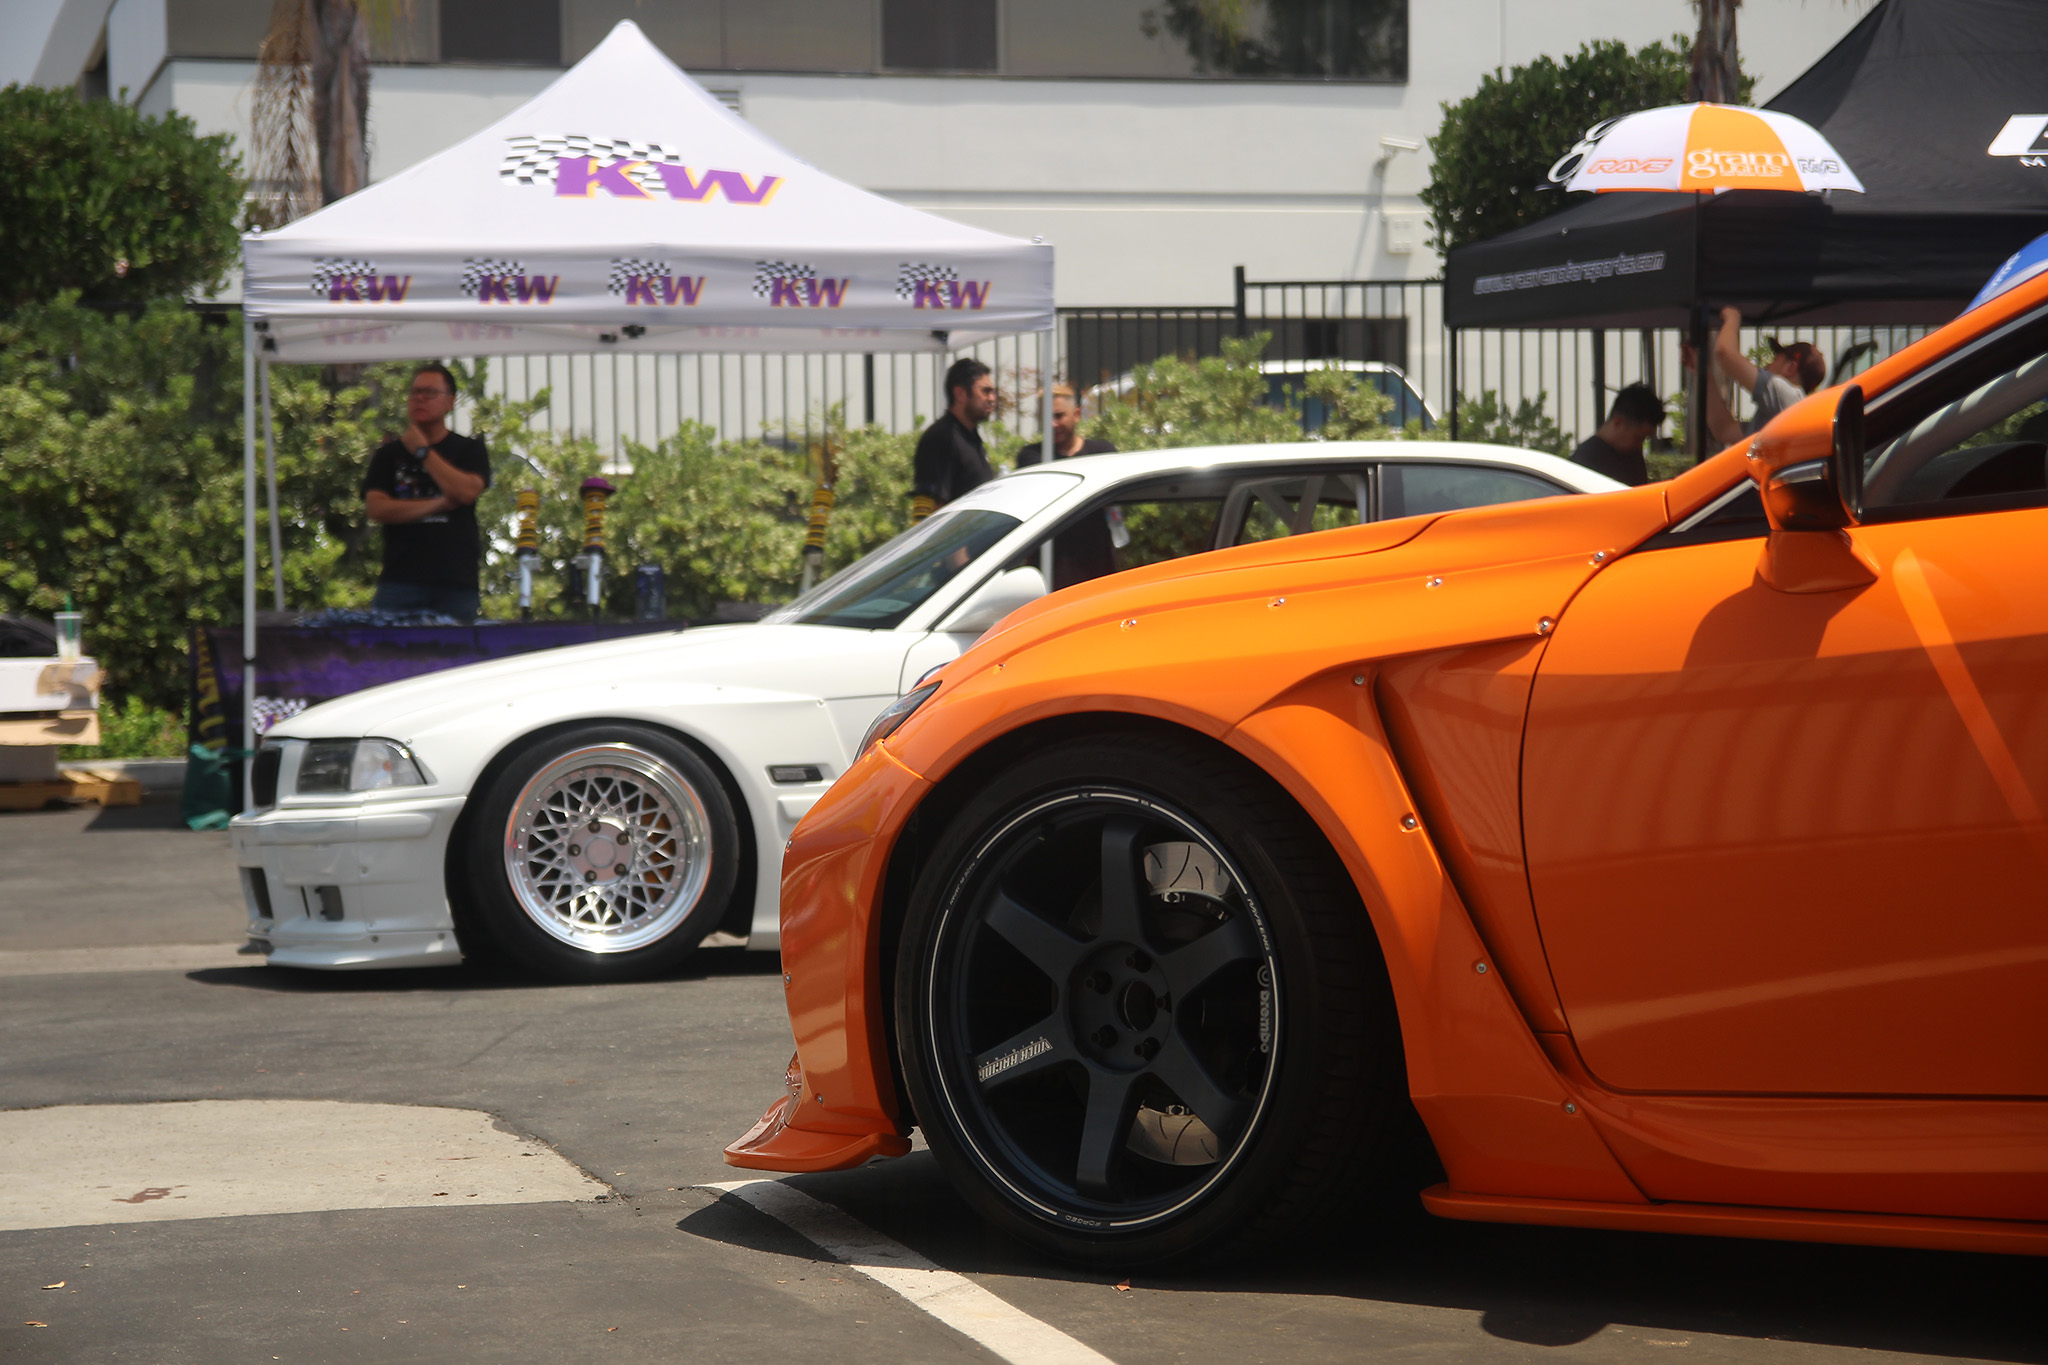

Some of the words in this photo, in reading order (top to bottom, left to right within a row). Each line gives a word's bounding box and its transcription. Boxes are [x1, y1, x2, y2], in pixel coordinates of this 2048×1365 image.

[1586, 158, 1674, 176] RAYS
[1687, 149, 1790, 179] gram
[553, 155, 787, 206] KW
[328, 274, 412, 304] KW
[479, 274, 561, 305] KW
[625, 275, 705, 306] KW
[770, 277, 850, 308] KW
[913, 279, 991, 310] KW
[1260, 990, 1271, 1053] brembo
[1064, 1214, 1102, 1227] FORGED
